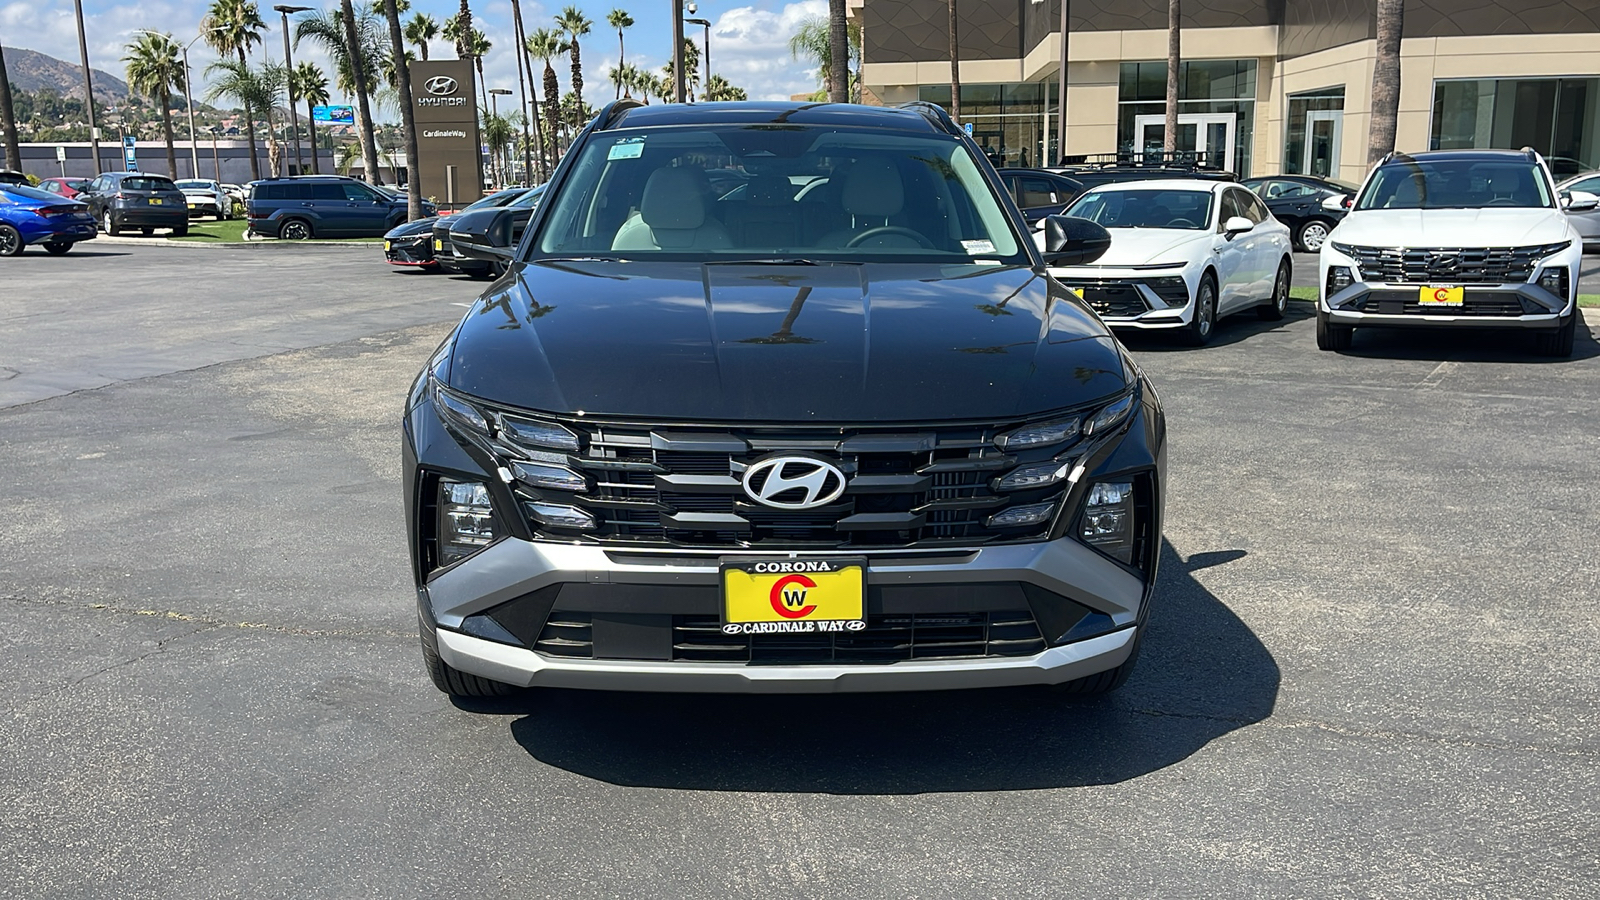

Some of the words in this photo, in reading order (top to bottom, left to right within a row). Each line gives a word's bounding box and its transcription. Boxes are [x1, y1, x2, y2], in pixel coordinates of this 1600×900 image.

[418, 97, 467, 106] HYUNDAI
[423, 130, 466, 138] CardinaleWay
[755, 561, 831, 573] CORONA
[769, 574, 818, 619] C
[783, 589, 807, 607] W
[743, 621, 814, 634] CARDINALE
[818, 620, 846, 632] WAY
